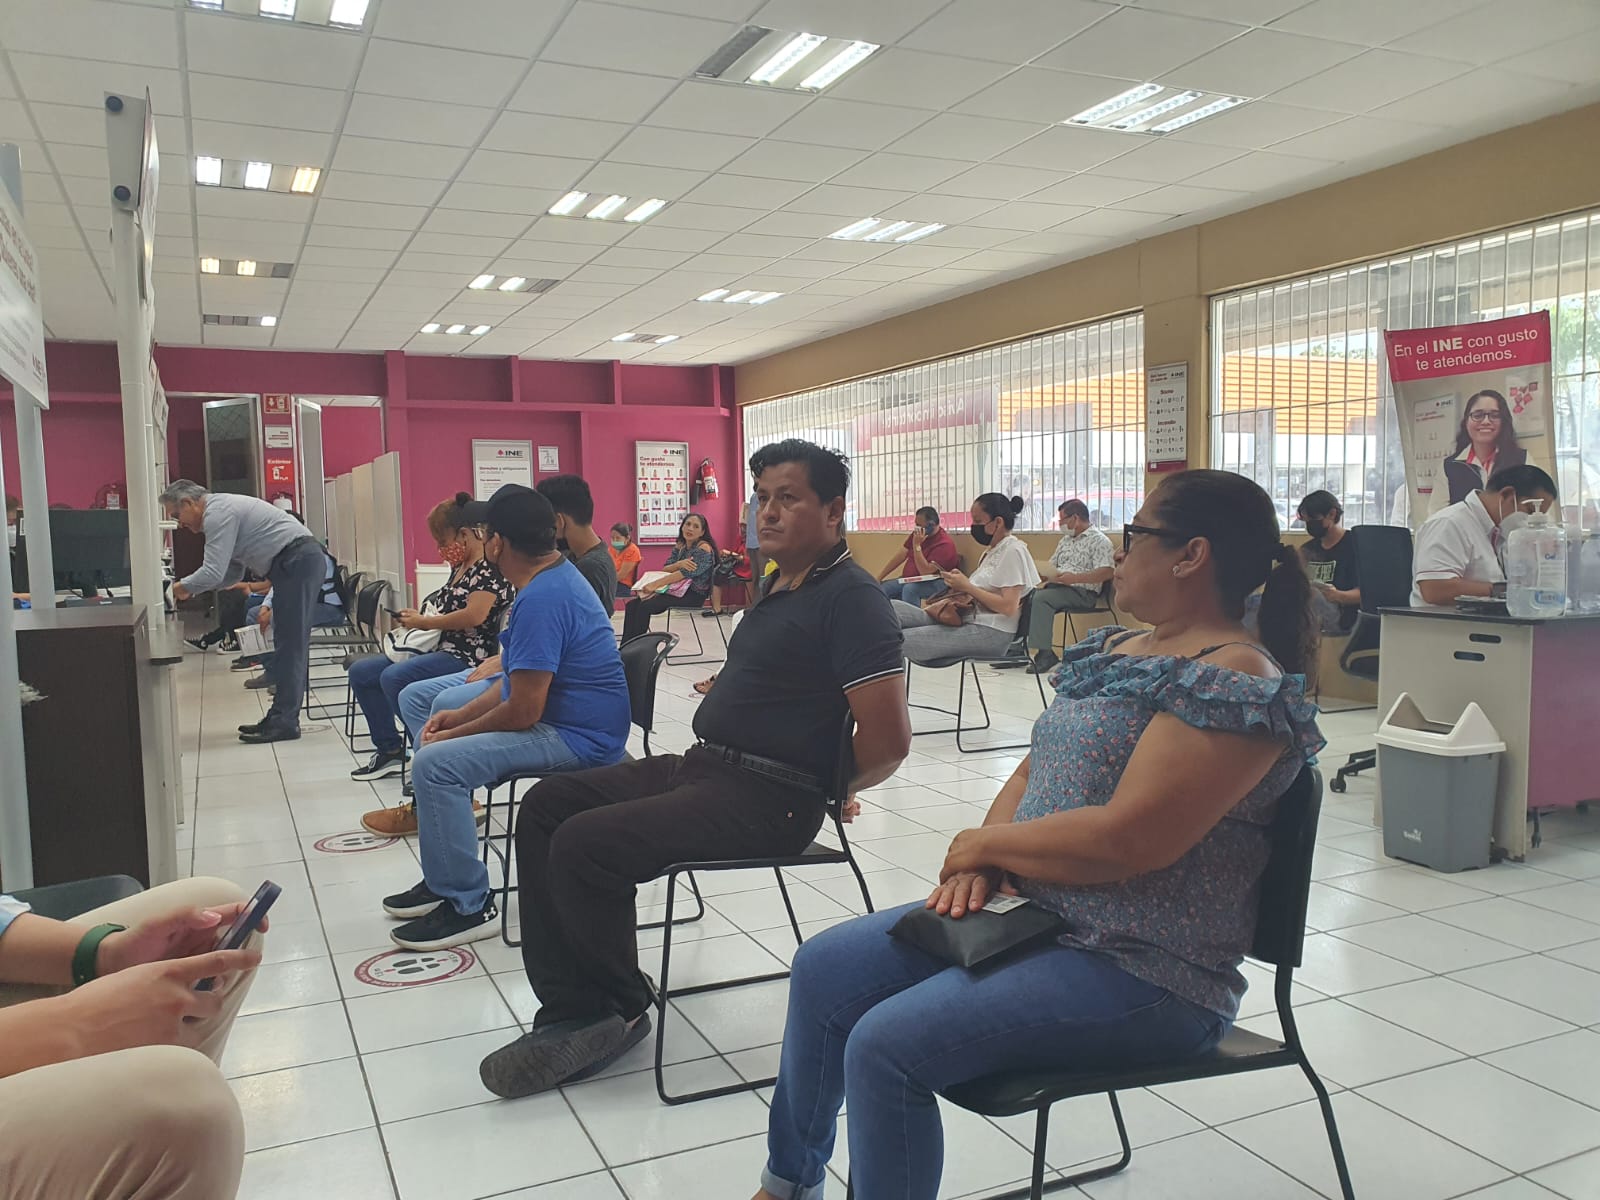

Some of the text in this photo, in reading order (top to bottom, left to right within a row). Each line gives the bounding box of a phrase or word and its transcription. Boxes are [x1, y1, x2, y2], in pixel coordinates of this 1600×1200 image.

[1394, 328, 1538, 357] En el INE con gusto
[1416, 349, 1517, 371] te atendemos.
